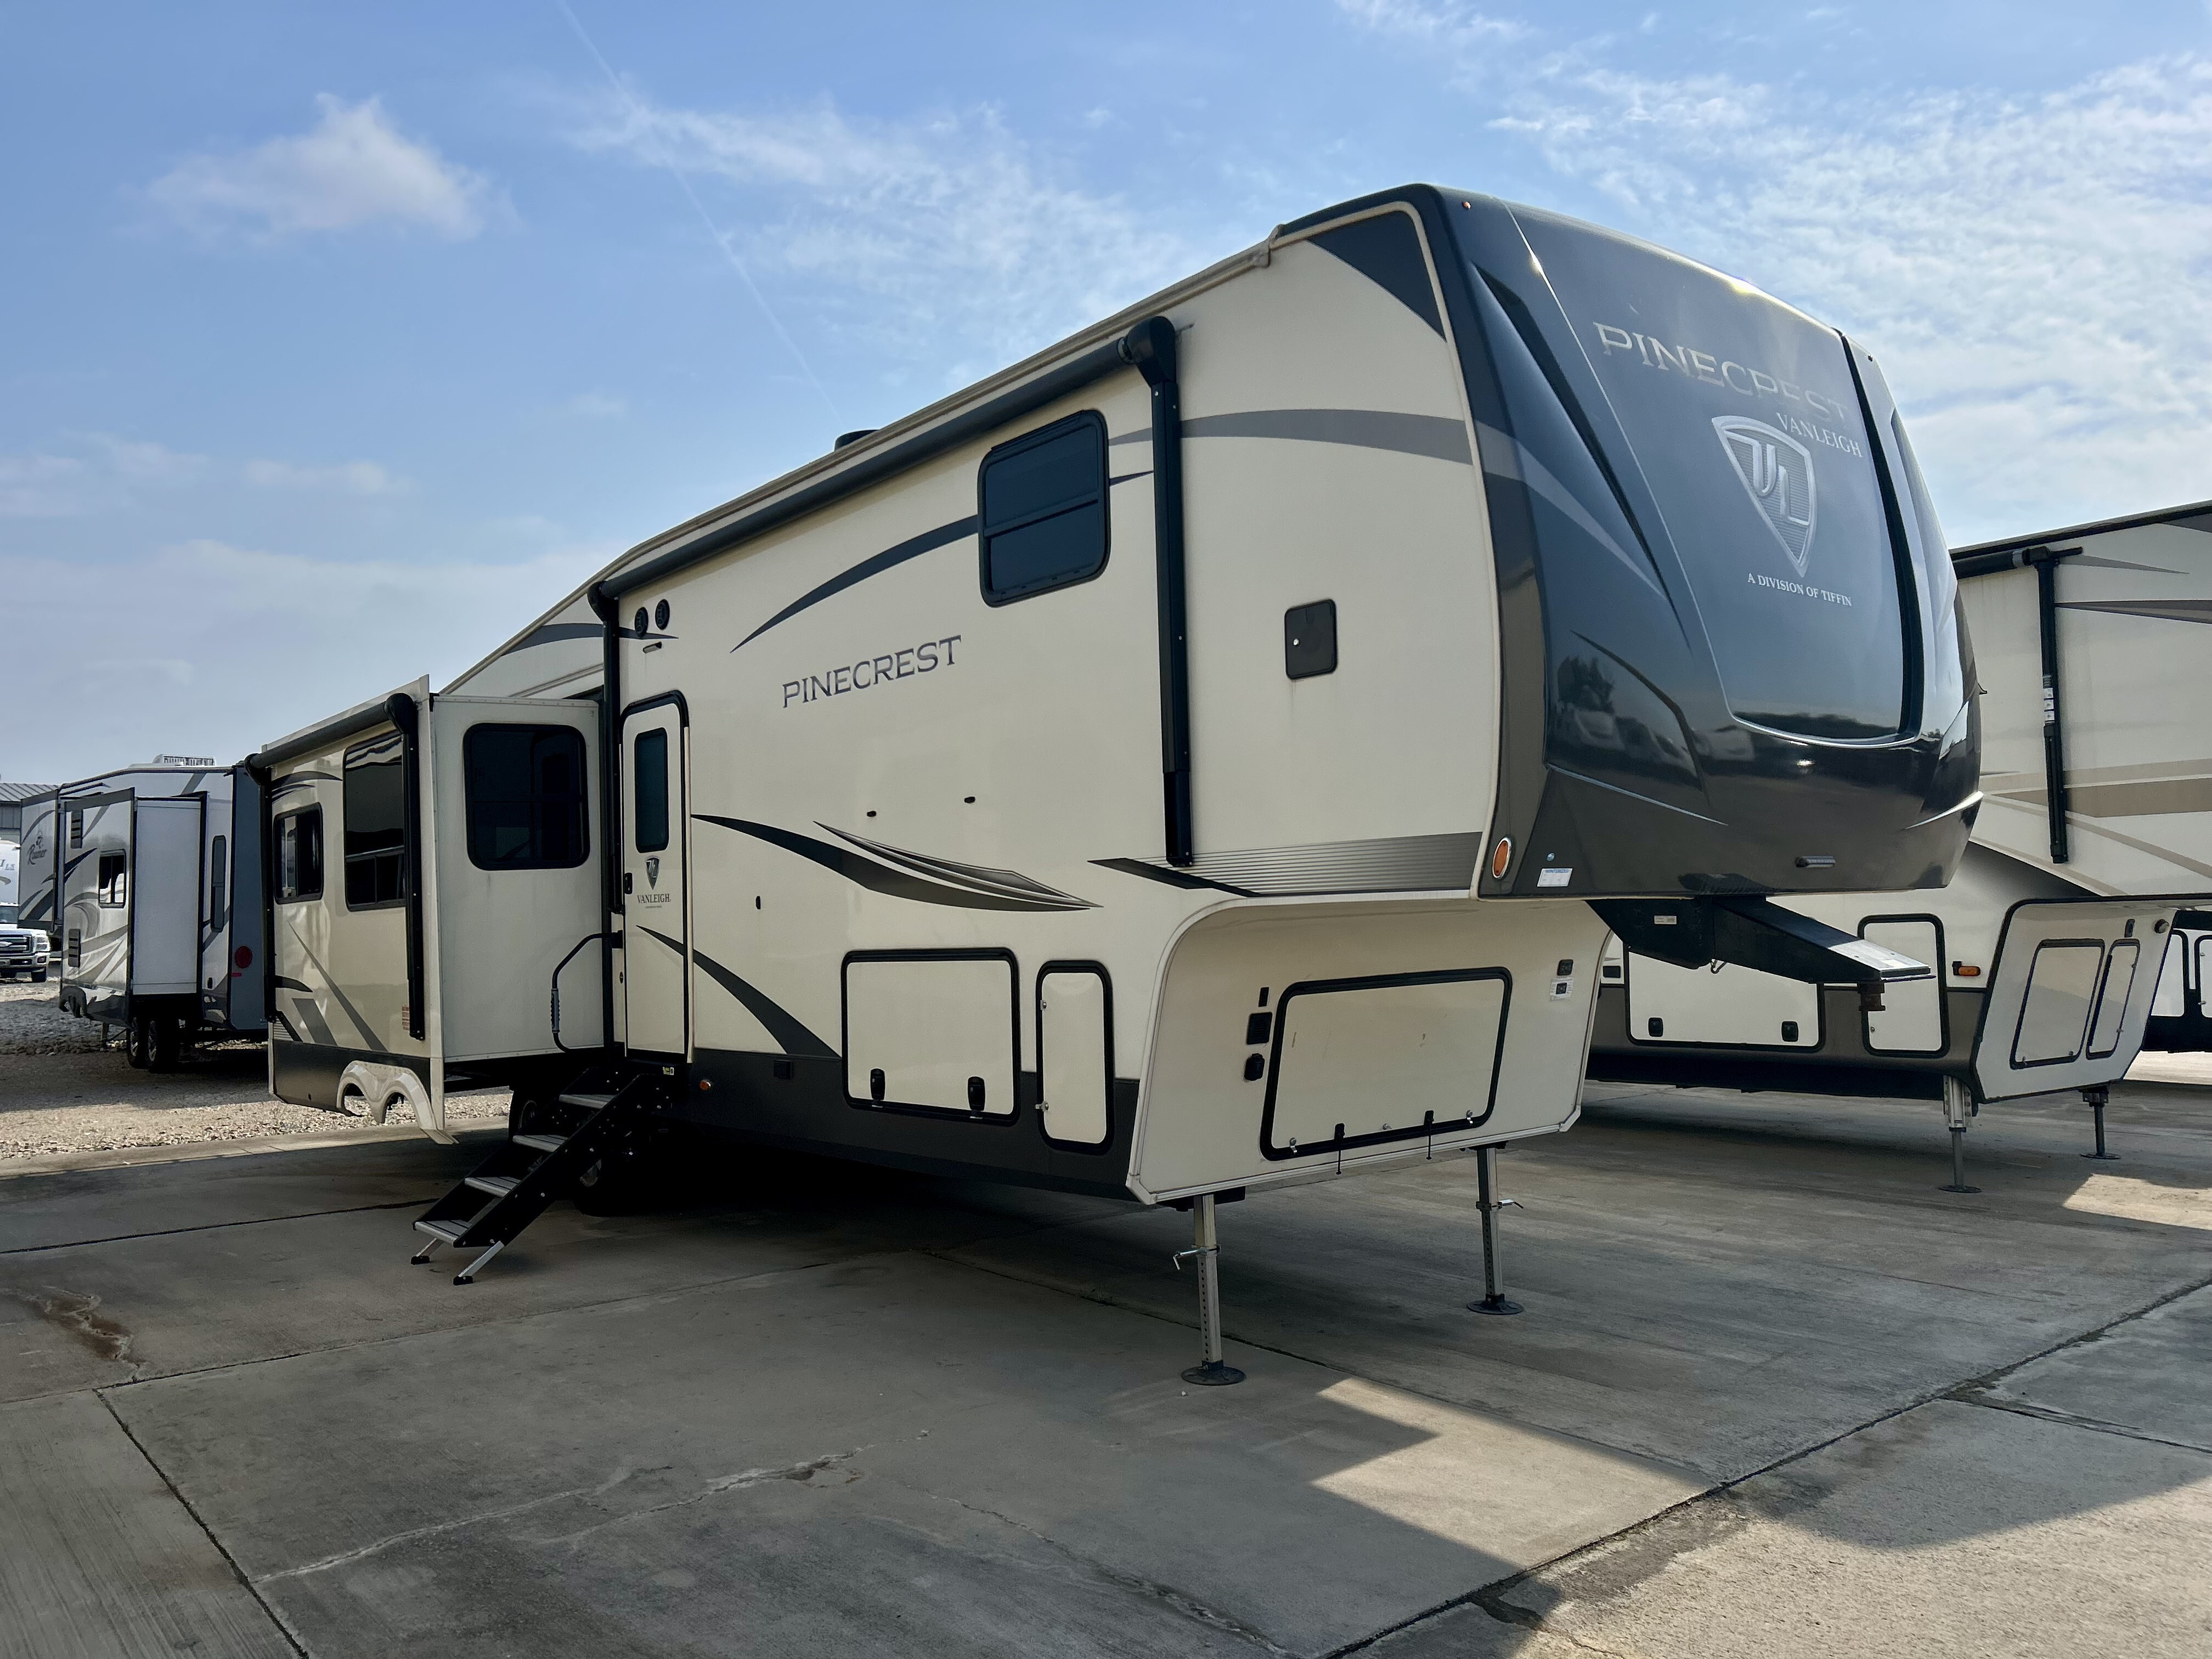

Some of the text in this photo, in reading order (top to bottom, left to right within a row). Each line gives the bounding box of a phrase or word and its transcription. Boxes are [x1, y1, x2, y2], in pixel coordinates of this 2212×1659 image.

[1593, 321, 1849, 424] PINECREST
[1776, 412, 1864, 458] VANLEIGH
[1747, 572, 1852, 607] A DIVISION OF TIFFIN
[782, 635, 962, 708] PINECREST
[637, 893, 670, 904] VANLEIGH
